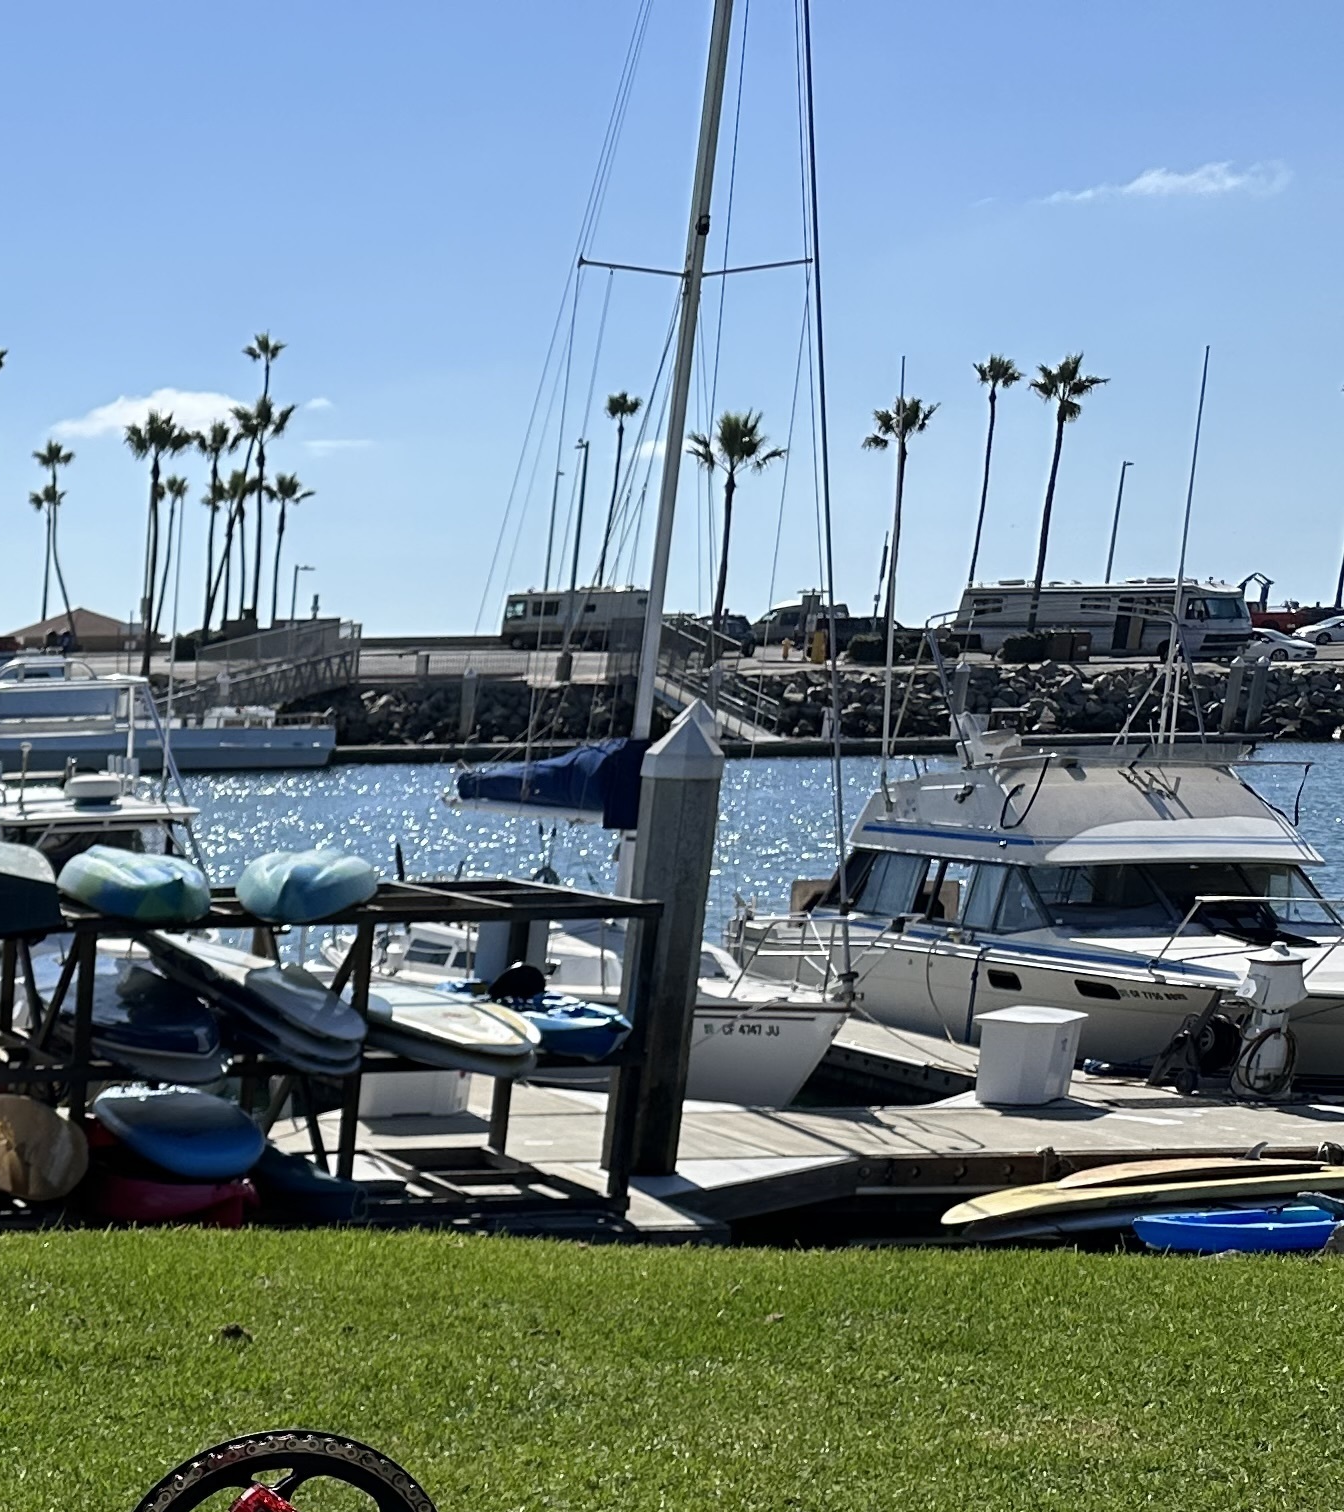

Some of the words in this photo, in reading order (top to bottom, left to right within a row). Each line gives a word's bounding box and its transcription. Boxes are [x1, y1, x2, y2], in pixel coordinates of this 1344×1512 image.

[722, 1023, 735, 1035] CF
[738, 1023, 762, 1035] 4747
[765, 1024, 780, 1036] JU
